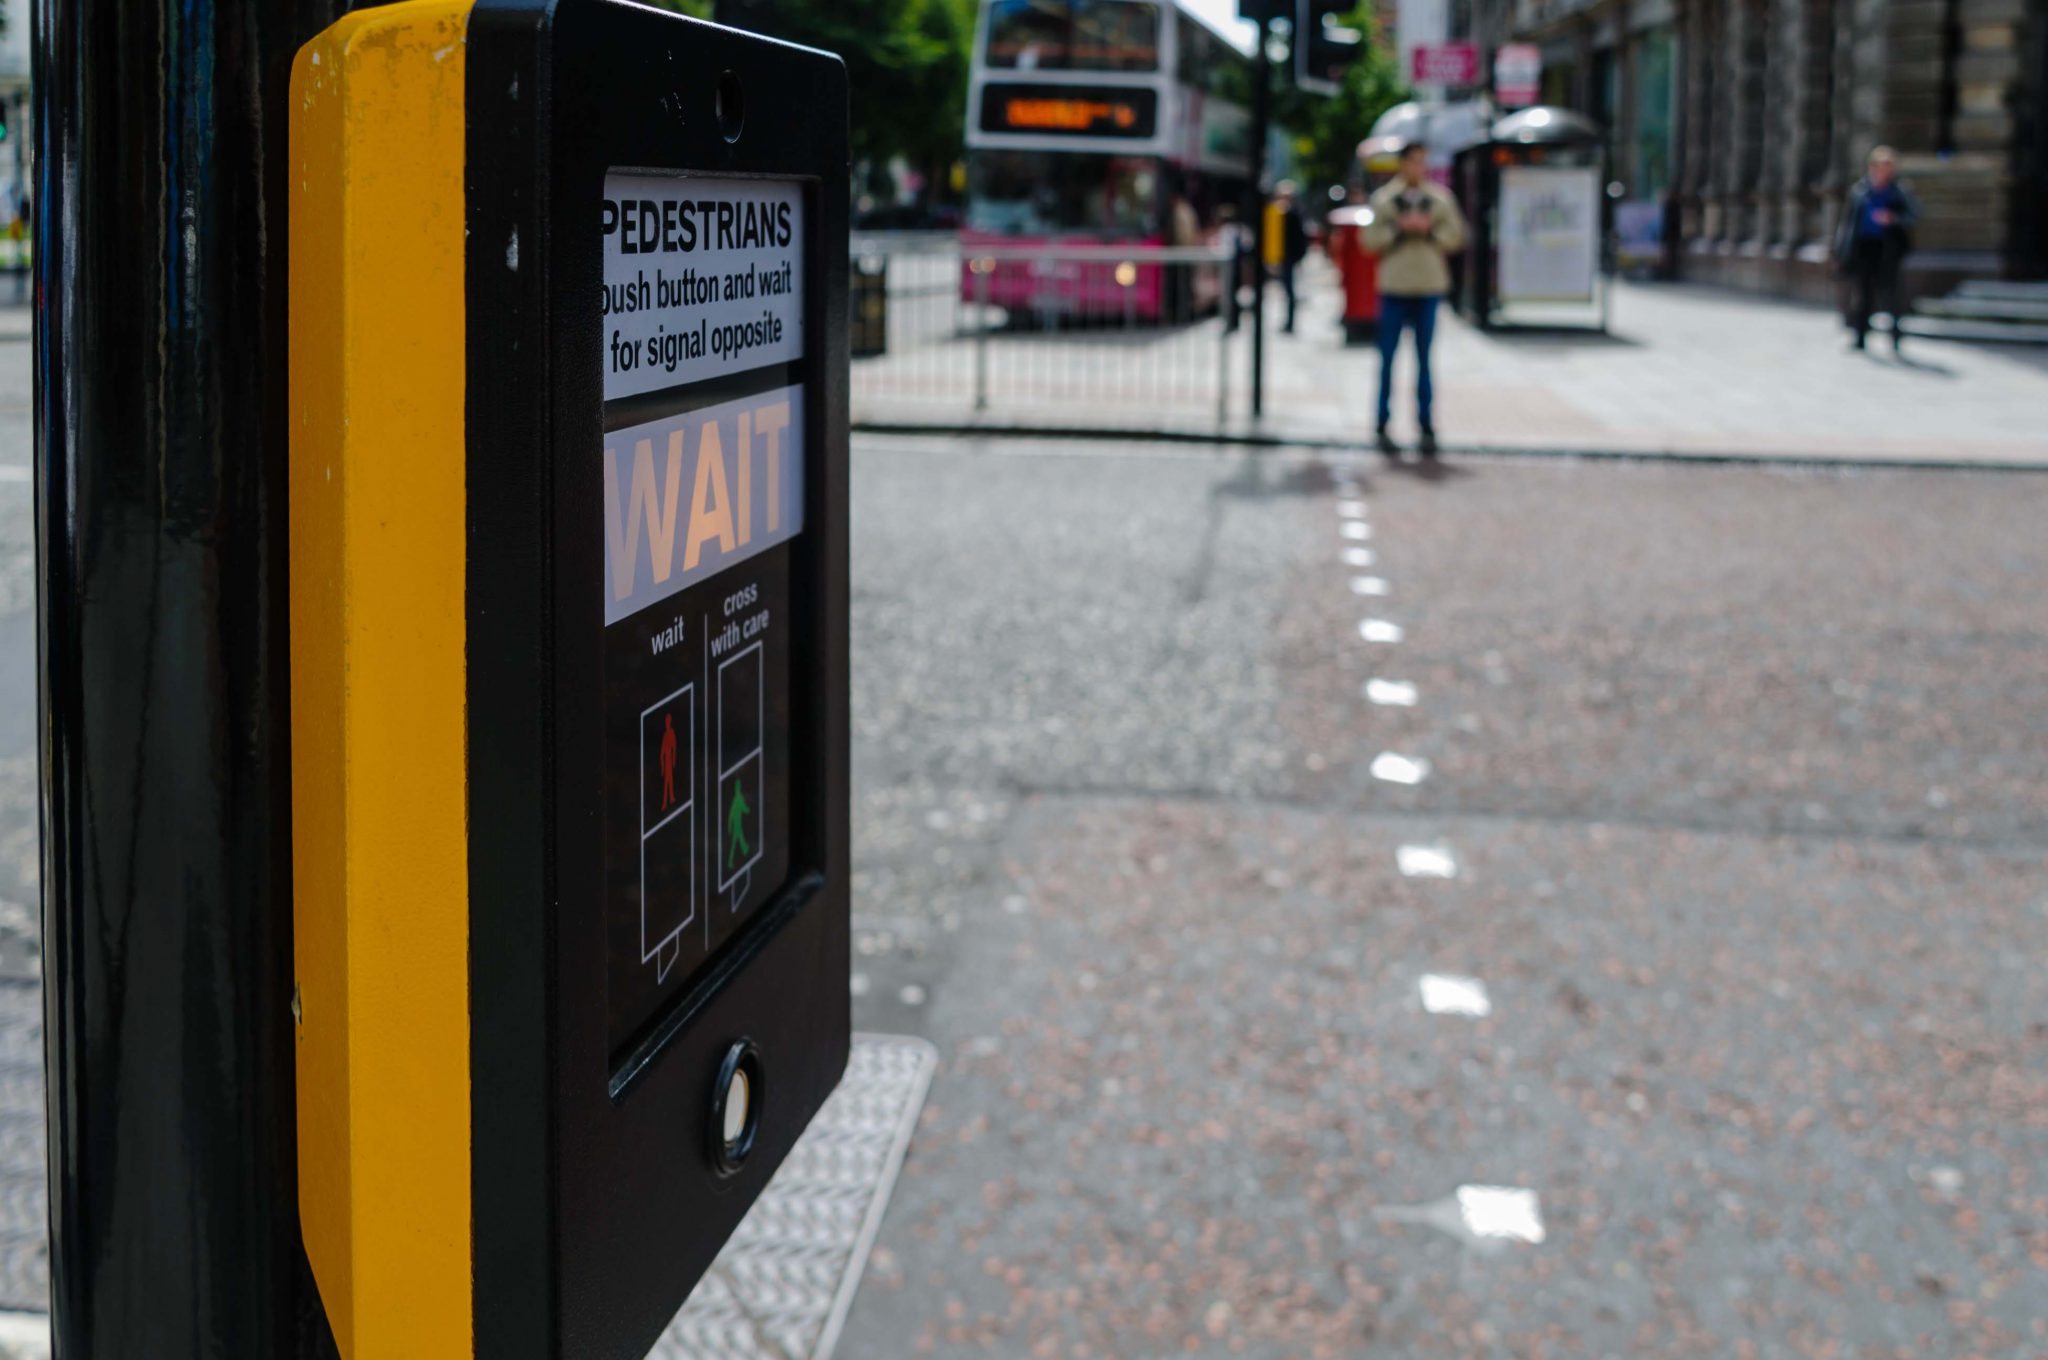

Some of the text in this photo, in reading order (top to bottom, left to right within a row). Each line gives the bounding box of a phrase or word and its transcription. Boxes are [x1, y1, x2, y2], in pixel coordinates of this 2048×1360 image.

[603, 200, 792, 254] PEDESTRIANS
[657, 267, 719, 308] button
[724, 262, 755, 301] and
[759, 260, 792, 297] wait
[611, 310, 783, 373] for signal opposite
[603, 401, 790, 602] WAIT
[723, 583, 758, 616] cross
[651, 615, 684, 655] wait
[711, 609, 769, 658] with care
